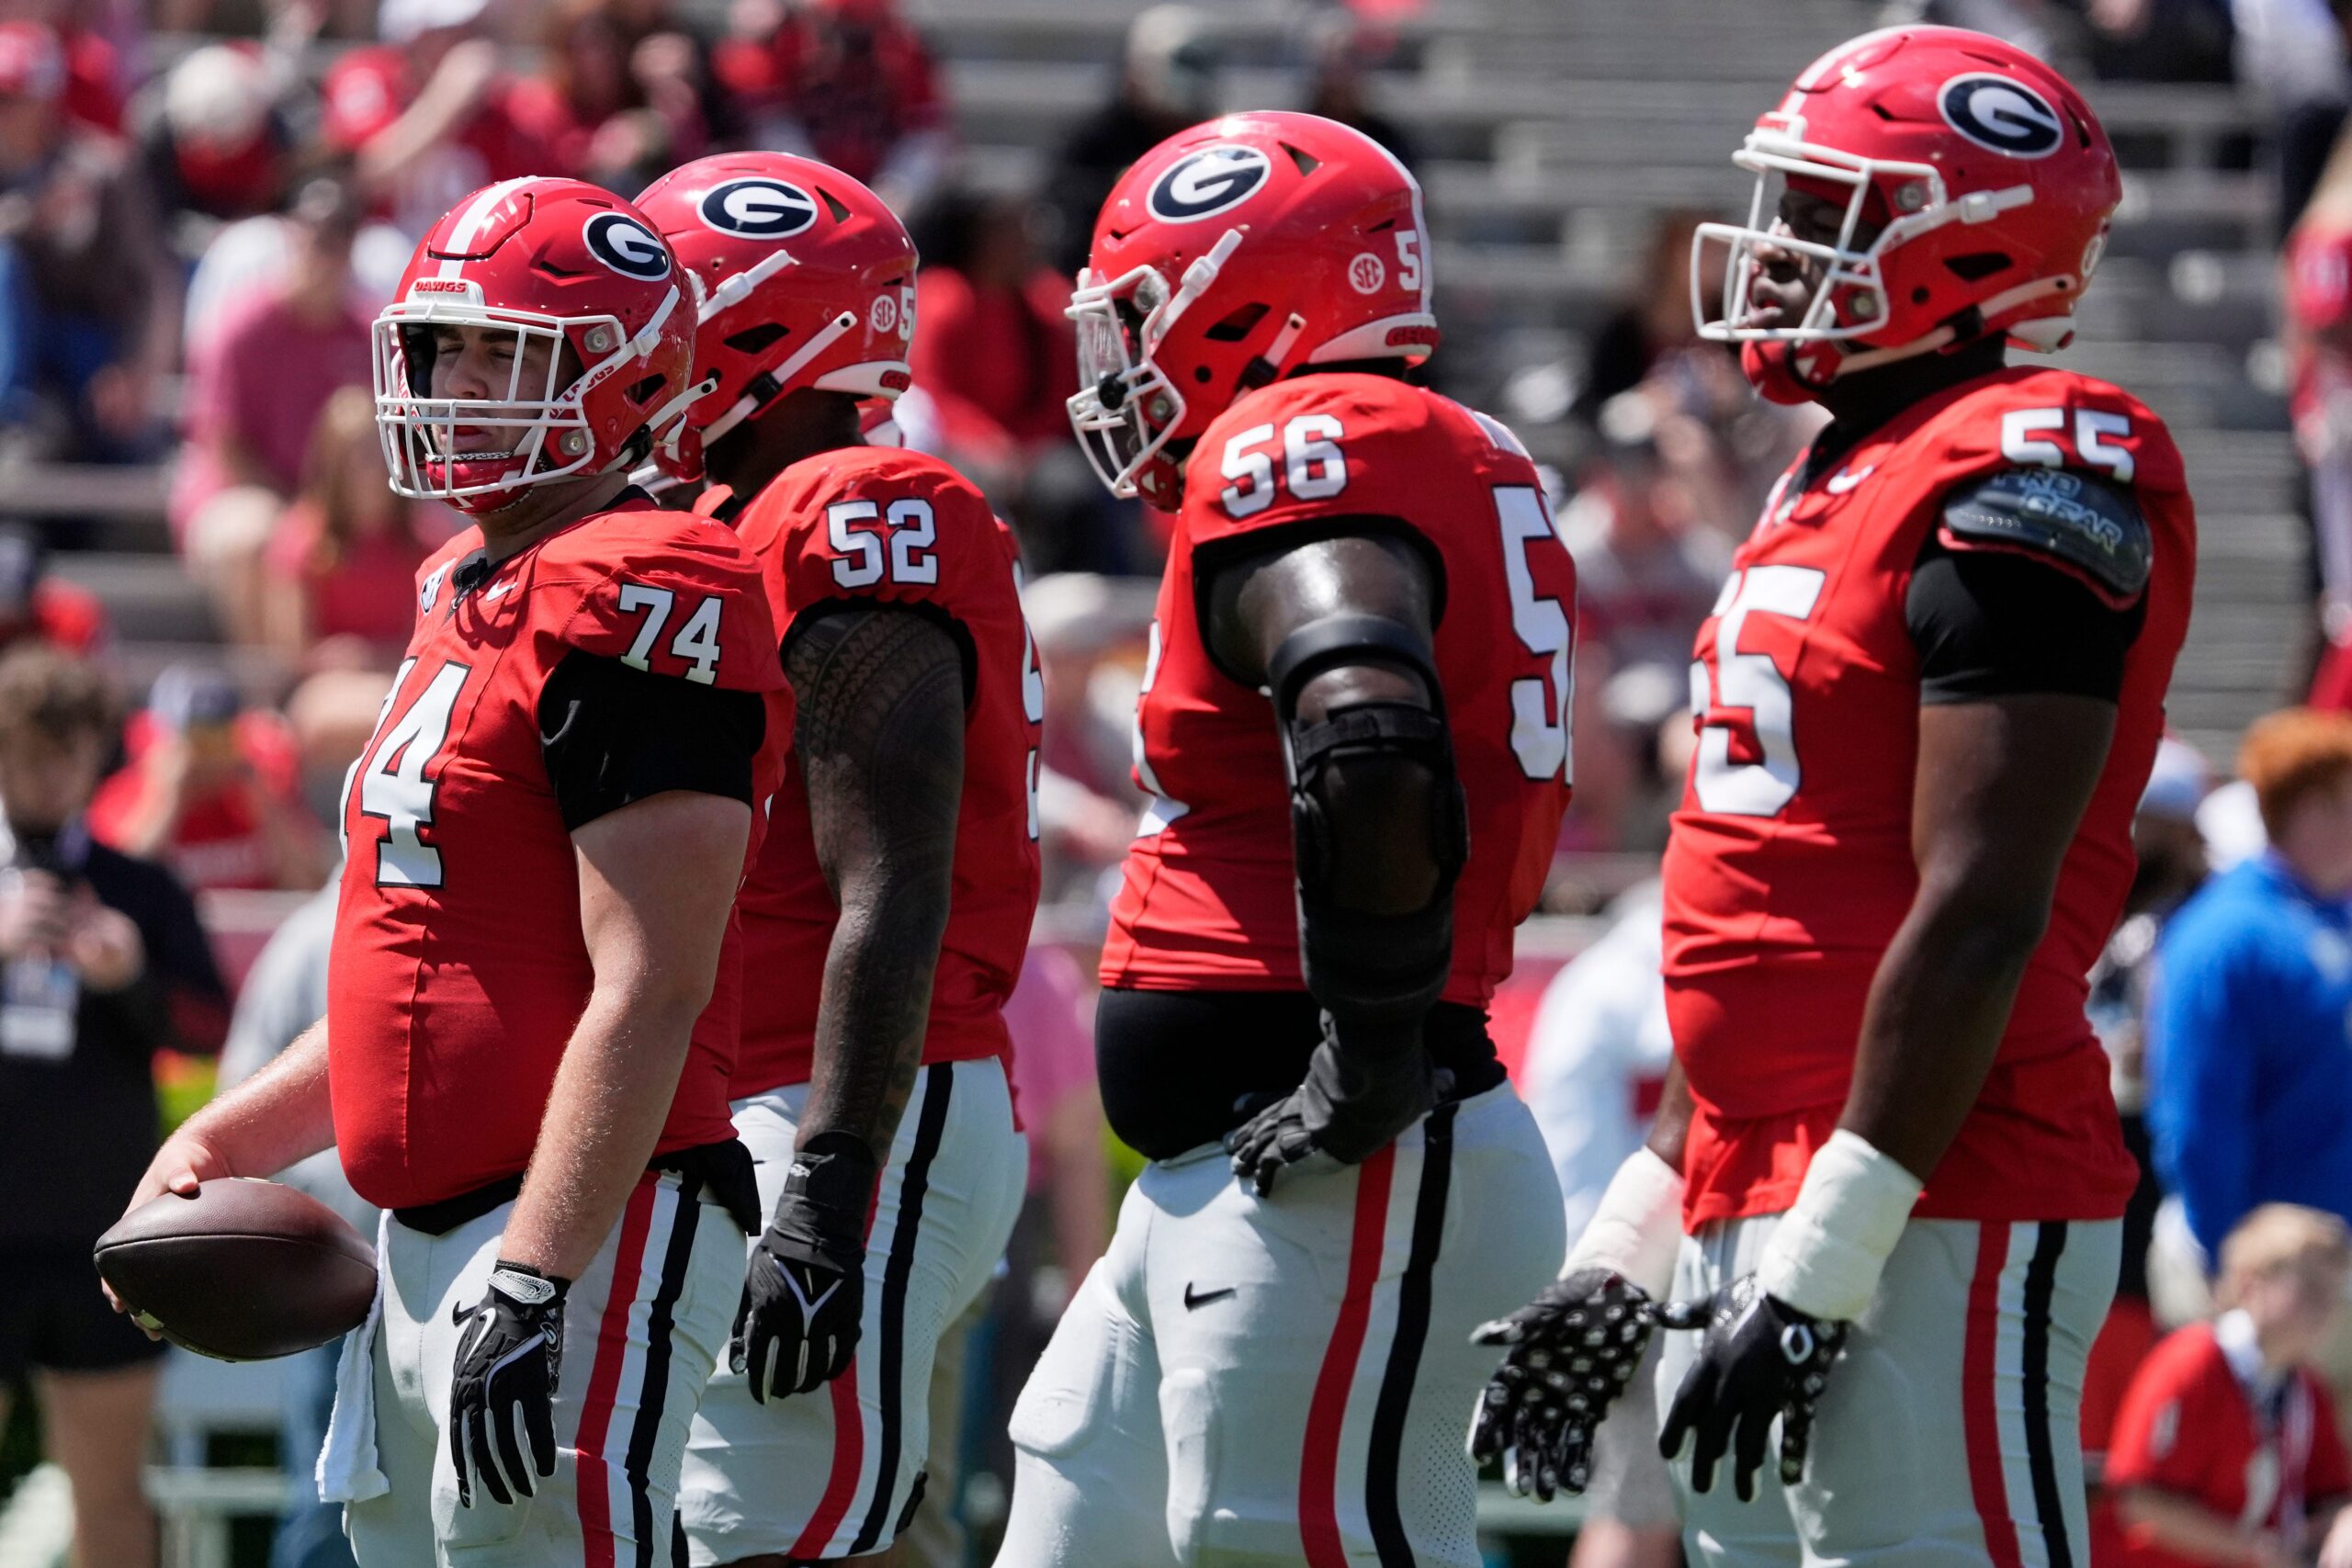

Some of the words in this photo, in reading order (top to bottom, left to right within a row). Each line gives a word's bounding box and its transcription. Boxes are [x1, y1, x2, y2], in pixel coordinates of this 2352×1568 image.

[414, 280, 467, 293] DAWGS
[1351, 256, 1382, 291] SEC
[1220, 413, 1348, 520] 56
[2001, 407, 2134, 483] 55
[827, 496, 938, 590] 52
[617, 582, 723, 686] 74
[1492, 483, 1573, 786] 5
